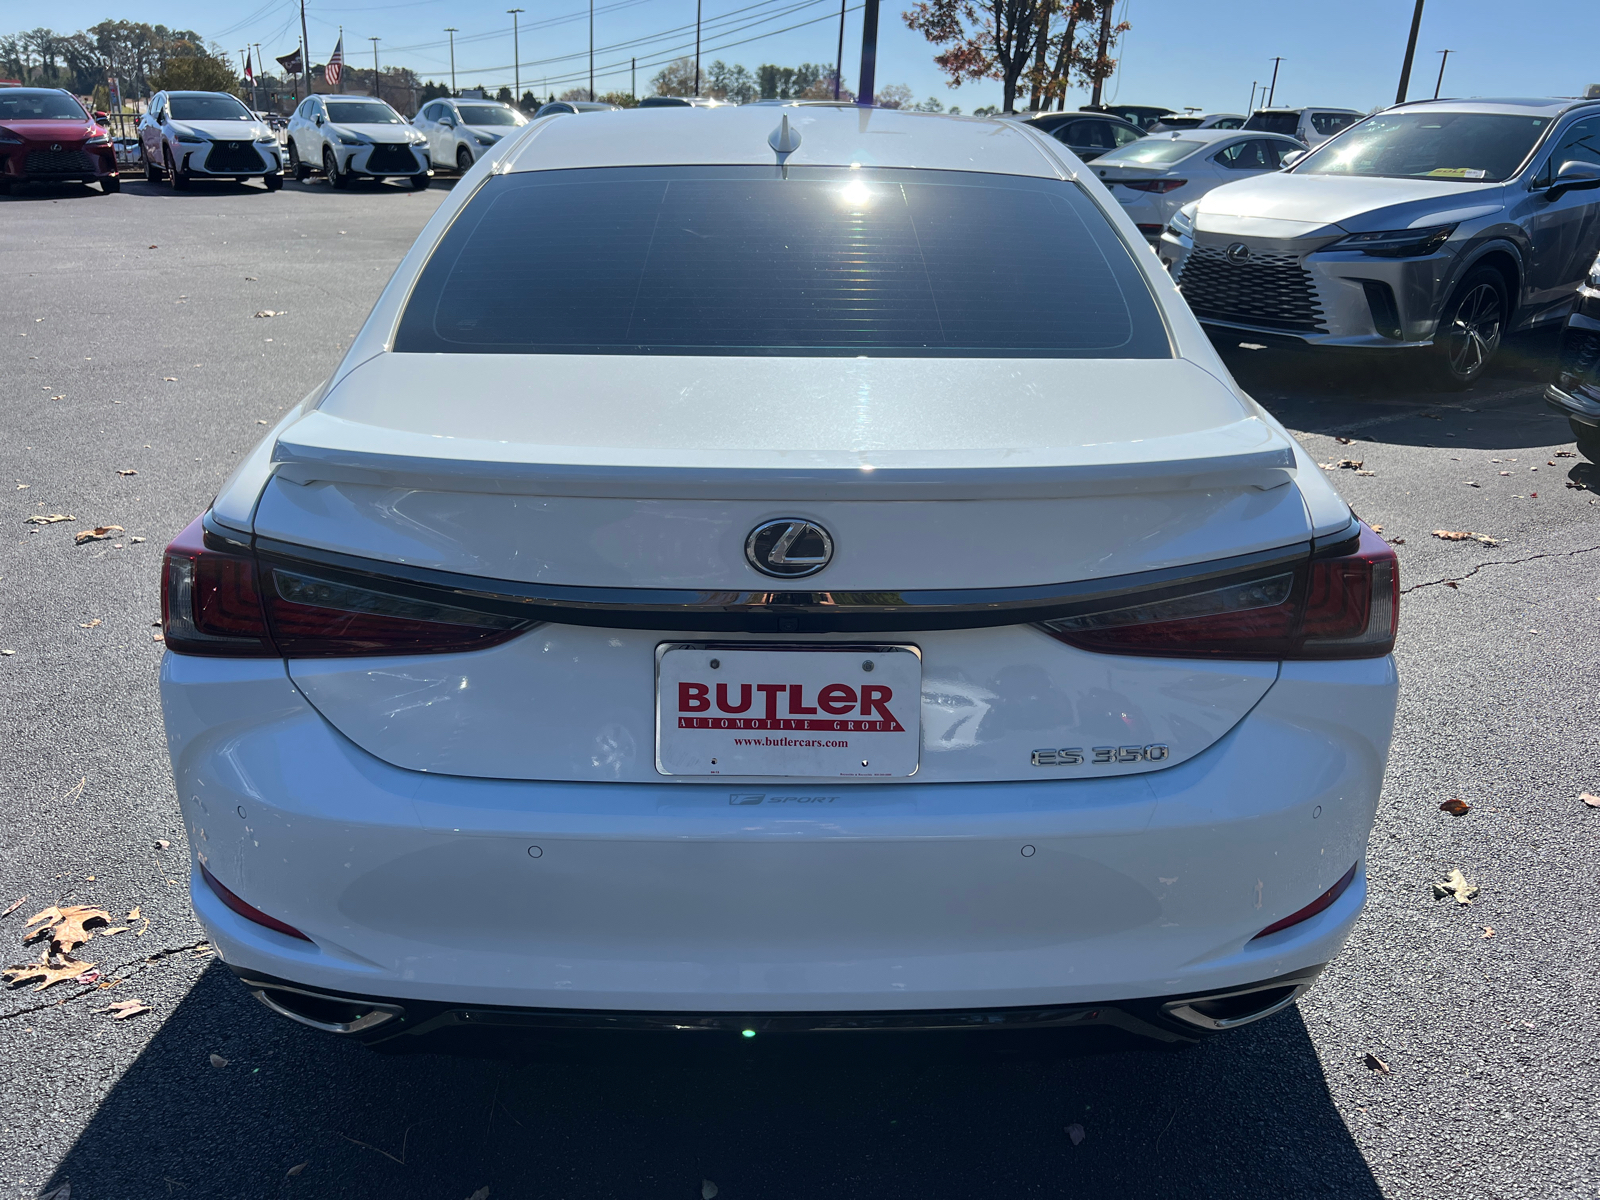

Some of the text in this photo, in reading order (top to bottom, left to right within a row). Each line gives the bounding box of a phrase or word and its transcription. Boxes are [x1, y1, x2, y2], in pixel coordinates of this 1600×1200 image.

[679, 718, 897, 731] AUTOMOTIVE GROUP
[734, 736, 849, 748] www.butlercars.com
[1031, 743, 1169, 767] ES 350
[767, 796, 841, 804] SPORT
